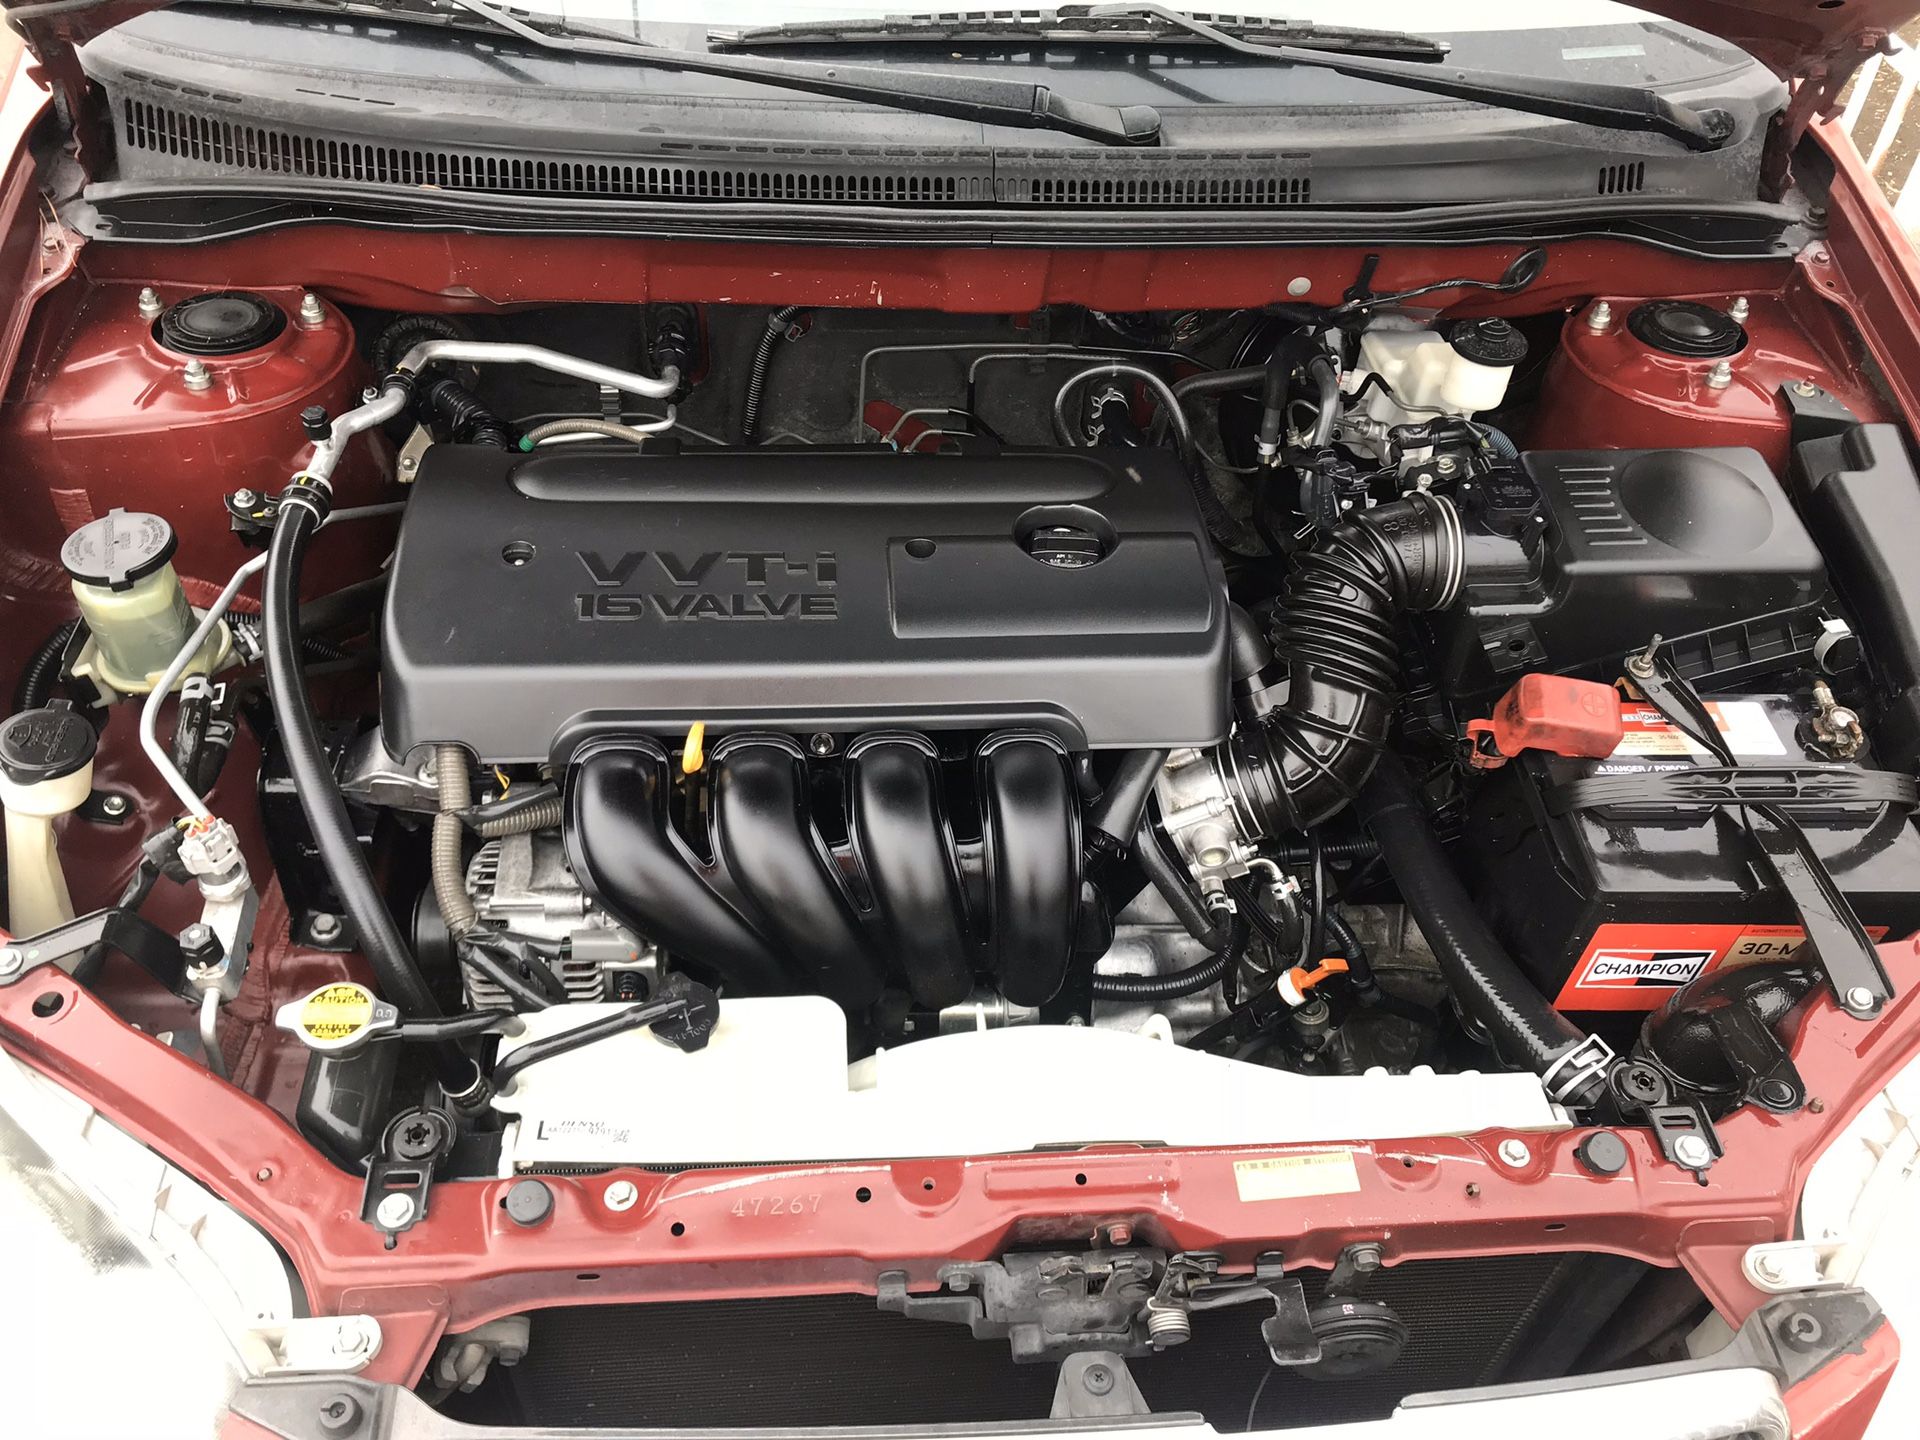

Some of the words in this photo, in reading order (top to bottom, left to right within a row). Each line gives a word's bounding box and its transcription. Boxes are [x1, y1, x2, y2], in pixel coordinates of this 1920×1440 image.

[575, 593, 644, 621] 16
[649, 593, 838, 621] VALVE
[1593, 963, 1697, 975] CHAMPION
[537, 1120, 549, 1141] L
[731, 1194, 822, 1217] 47267
